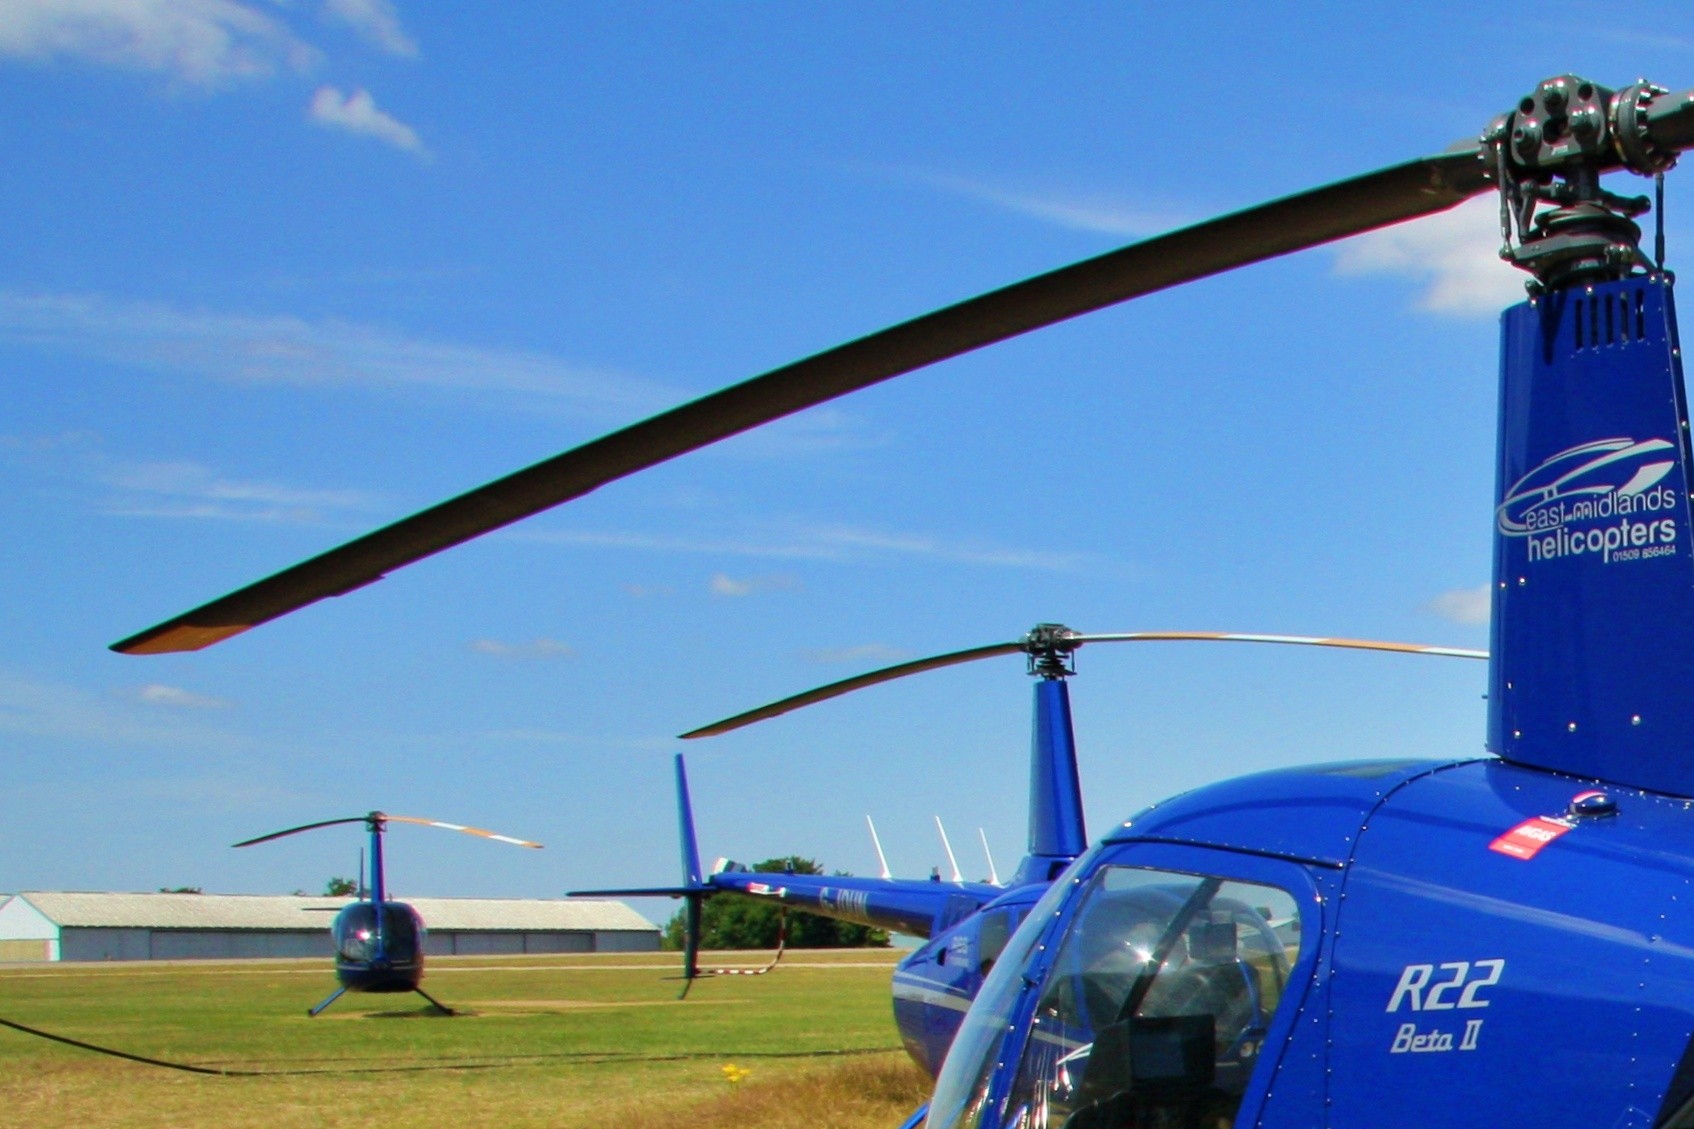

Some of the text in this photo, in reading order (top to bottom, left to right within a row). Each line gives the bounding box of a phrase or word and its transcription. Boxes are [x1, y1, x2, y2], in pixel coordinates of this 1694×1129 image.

[1526, 485, 1676, 529] east midlands
[1528, 518, 1676, 563] helicopters
[1613, 549, 1640, 562] 01509
[1385, 959, 1505, 1013] R22
[1390, 1023, 1453, 1054] Beta
